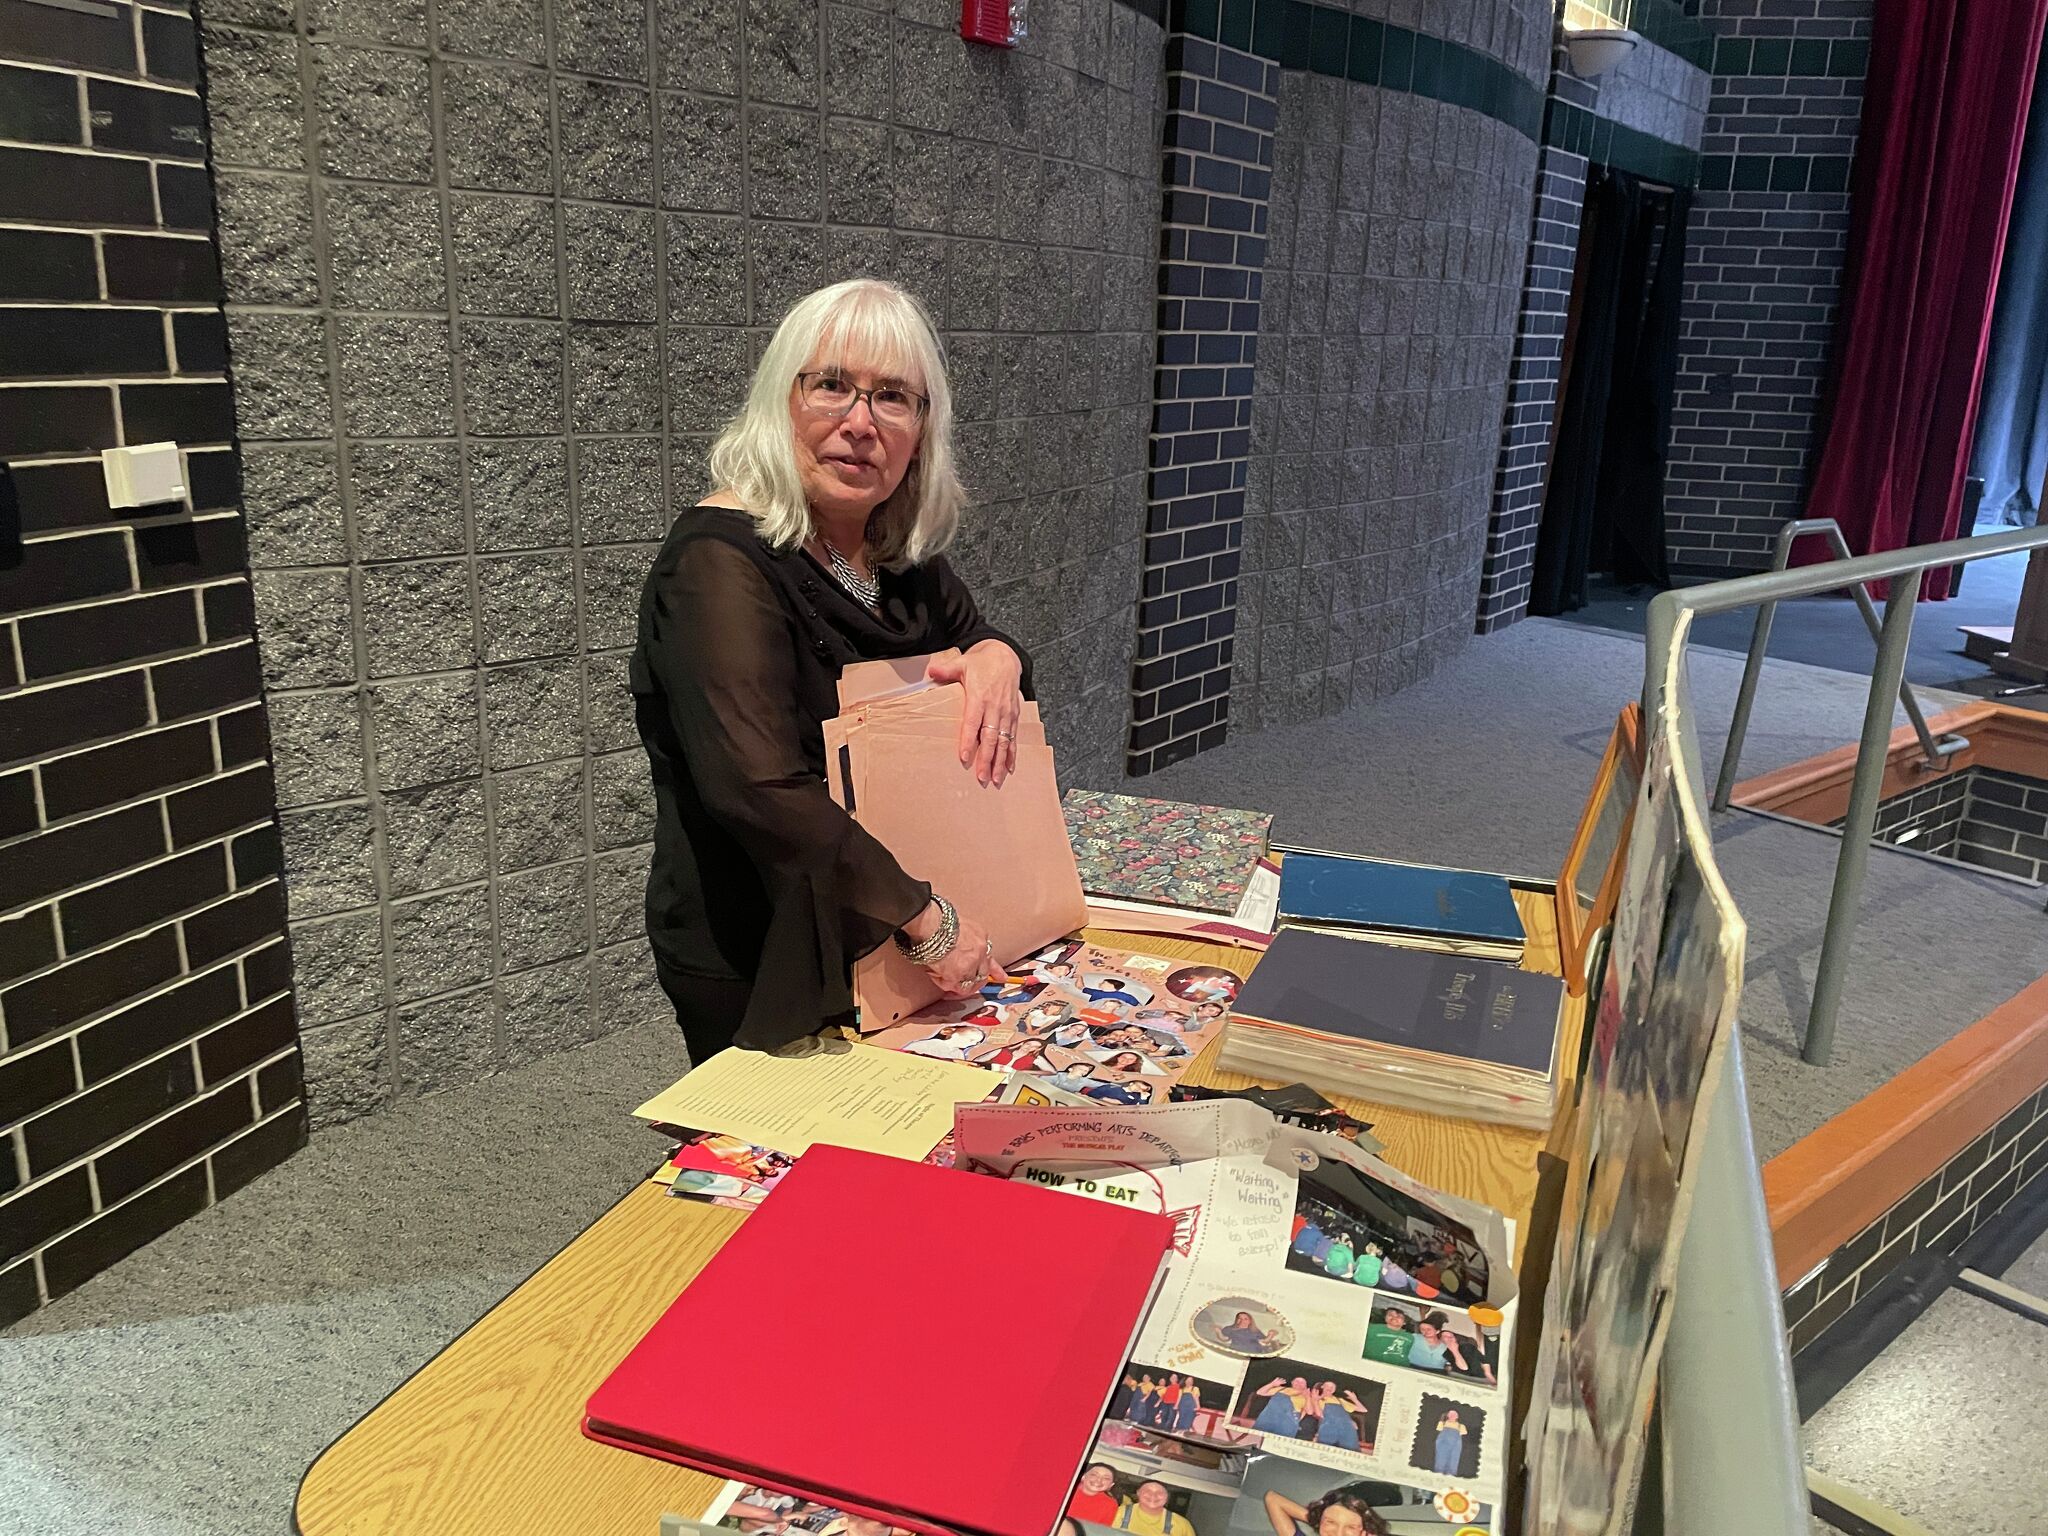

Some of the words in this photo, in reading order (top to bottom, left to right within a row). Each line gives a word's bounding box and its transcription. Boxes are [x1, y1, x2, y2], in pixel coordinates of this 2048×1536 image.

[1037, 1121, 1103, 1137] PERFORMING
[1107, 1122, 1137, 1137] ARTS
[1107, 1143, 1126, 1151] PLAY
[1026, 1166, 1065, 1188] HOW
[1075, 1178, 1097, 1194] TO
[1105, 1184, 1139, 1203] EAT
